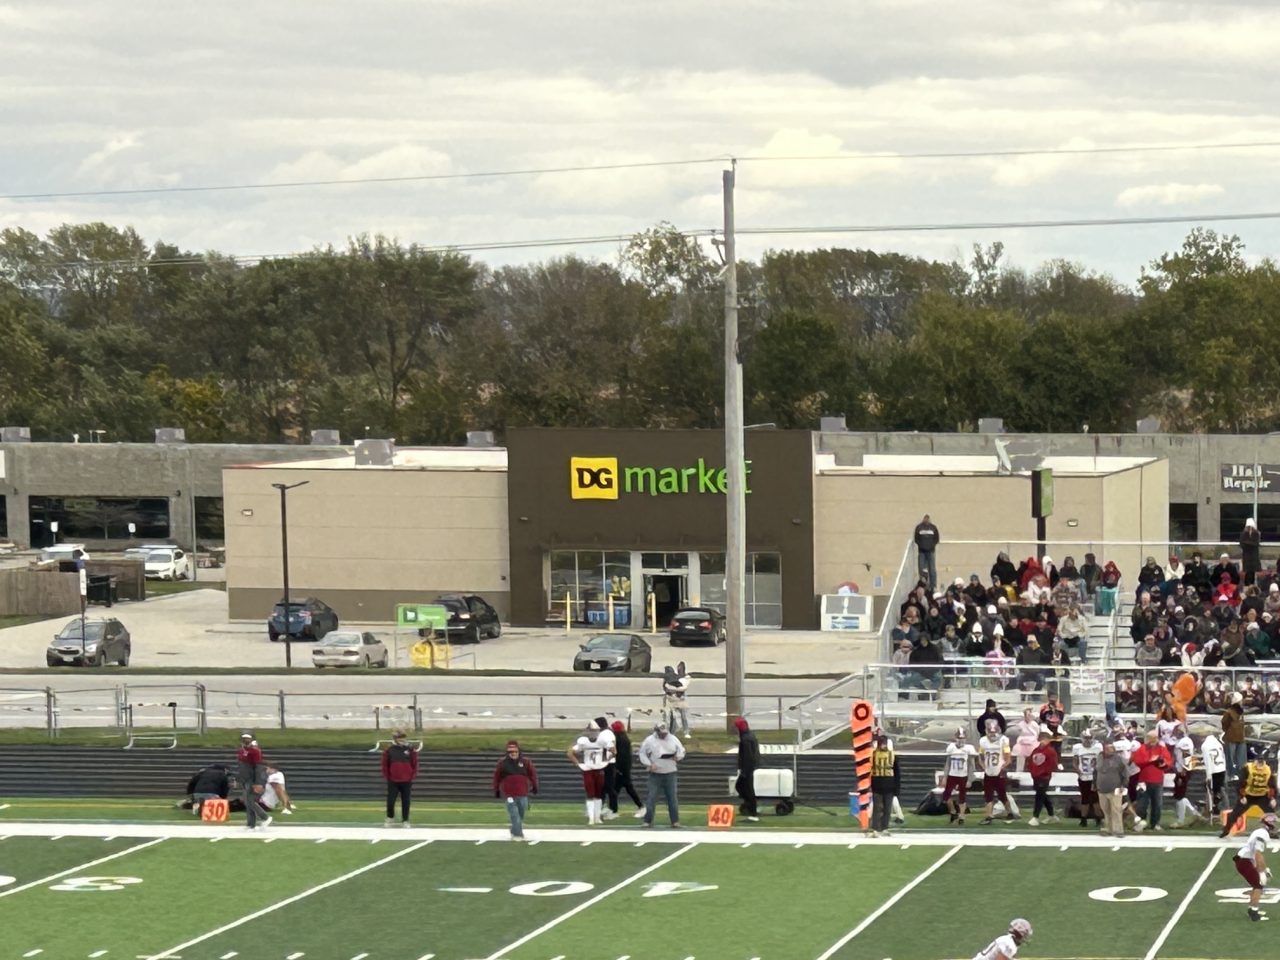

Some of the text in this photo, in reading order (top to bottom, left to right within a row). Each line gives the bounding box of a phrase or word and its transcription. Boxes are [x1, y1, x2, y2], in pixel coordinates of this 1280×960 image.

[576, 467, 613, 489] DG
[1232, 464, 1262, 477] Hal
[207, 802, 225, 820] 30
[711, 807, 730, 825] 40
